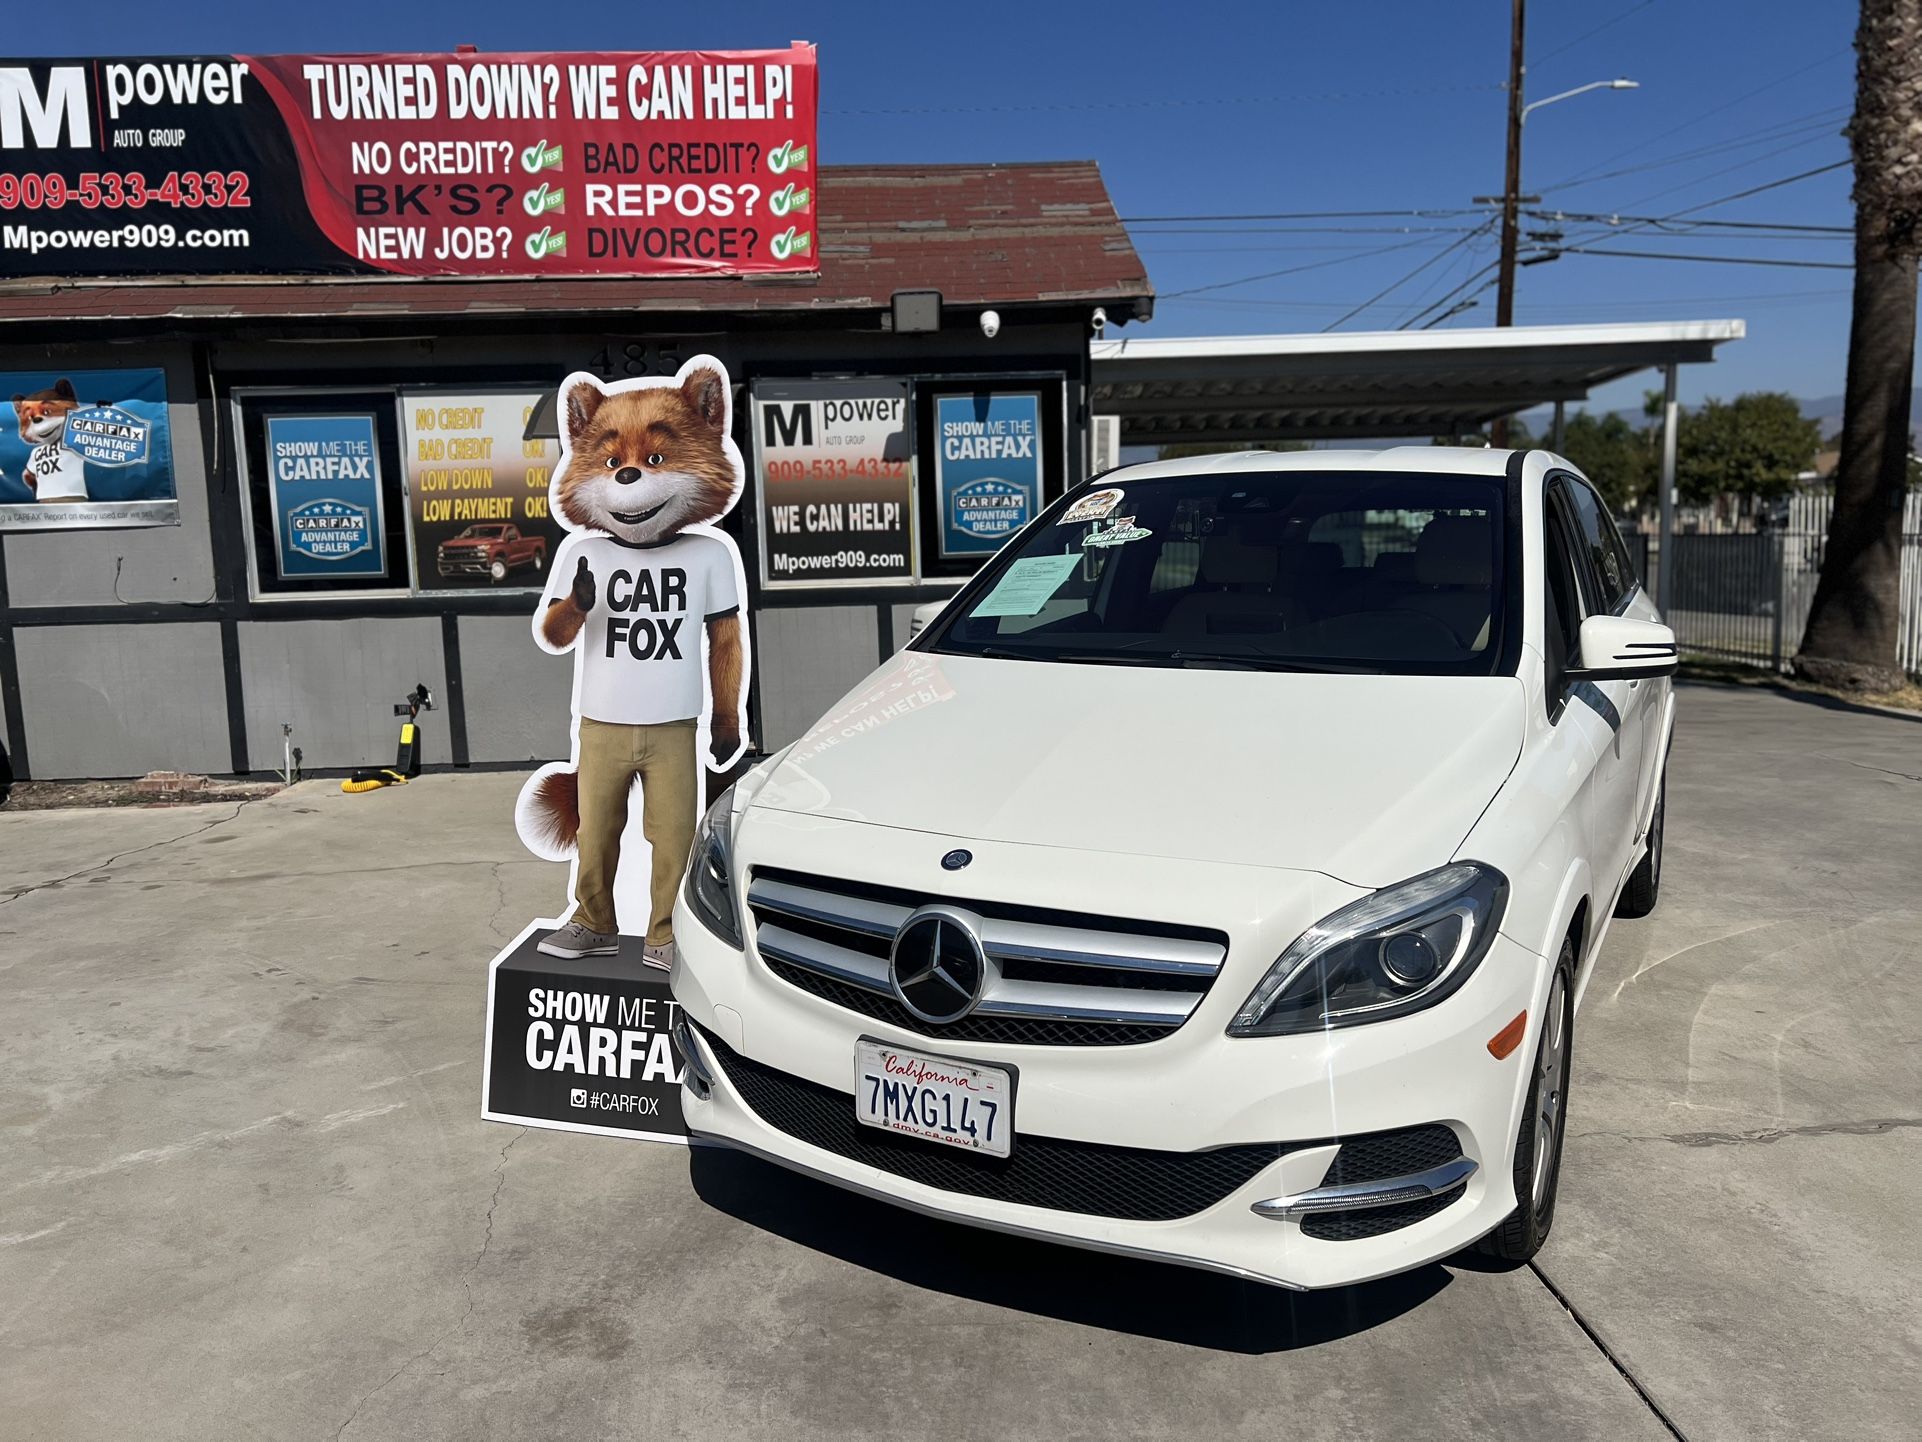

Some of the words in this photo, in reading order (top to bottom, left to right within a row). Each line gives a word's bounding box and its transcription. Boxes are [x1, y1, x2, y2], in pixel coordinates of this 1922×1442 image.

[106, 61, 248, 120] power
[303, 63, 437, 121] TURNED
[446, 63, 560, 121] DOWN?
[567, 63, 619, 121] WE
[627, 63, 694, 121] CAN
[703, 63, 794, 121] HELP!
[0, 66, 92, 149] M
[113, 129, 143, 148] AUTO
[149, 128, 186, 148] GROUP
[351, 141, 392, 175] NO
[399, 140, 515, 175] CREDIT?
[584, 142, 639, 174] BAD
[648, 141, 760, 174] CREDIT?
[0, 170, 250, 209] 909-533-4332
[354, 183, 515, 217] BK'S?
[585, 183, 762, 217] REPOS?
[3, 223, 250, 254] Mpower909.com
[356, 227, 426, 260] NEW
[434, 226, 513, 260] JOB?
[587, 227, 759, 260] DIVORCE?
[416, 408, 435, 430] NO
[438, 407, 484, 430] CREDIT
[763, 402, 813, 448] M
[824, 399, 900, 430] power
[72, 419, 144, 441] CARFAX
[825, 435, 842, 446] AUTO
[845, 435, 866, 446] GROUP
[944, 421, 984, 437] SHOW
[987, 421, 1006, 436] ME
[1007, 419, 1033, 435] THE
[74, 433, 137, 453] ADVANTAGE
[84, 446, 126, 462] DEALER
[276, 441, 319, 458] SHOW
[322, 440, 341, 456] ME
[343, 440, 369, 455] THE
[418, 439, 445, 461] BAD
[447, 437, 493, 460] CREDIT
[945, 436, 1033, 461] CARFAX
[35, 458, 63, 477] FOX
[278, 457, 371, 481] CARFAX
[420, 470, 450, 492] LOW
[452, 468, 492, 490] DOWN
[526, 467, 548, 489] OK!
[768, 457, 904, 482] 909-533-4332
[422, 499, 452, 522] LOW
[453, 497, 514, 521] PAYMENT
[524, 495, 548, 519] OK!
[959, 496, 1024, 510] CARFAX
[45, 512, 68, 522] Report
[69, 513, 78, 521] on
[79, 512, 98, 521] every
[99, 510, 116, 520] used
[117, 510, 128, 519] car
[295, 516, 363, 530] CARFAX
[772, 504, 800, 534] WE
[805, 503, 844, 532] CAN
[849, 502, 901, 532] HELP!
[963, 510, 1019, 522] ADVANTAGE
[972, 520, 1010, 532] DEALER
[301, 530, 360, 543] ADVANTAGE
[311, 541, 350, 553] DEALER
[774, 550, 904, 575] Mpower909.com
[606, 567, 688, 613] CAR
[605, 617, 684, 661] FOX
[527, 987, 610, 1024] SHOW
[617, 996, 657, 1029] ME
[885, 1054, 980, 1092] California
[589, 1091, 659, 1116] #CARFOX
[864, 1074, 998, 1142] 7MXG147
[892, 1121, 971, 1146] dmv.ca.gov
